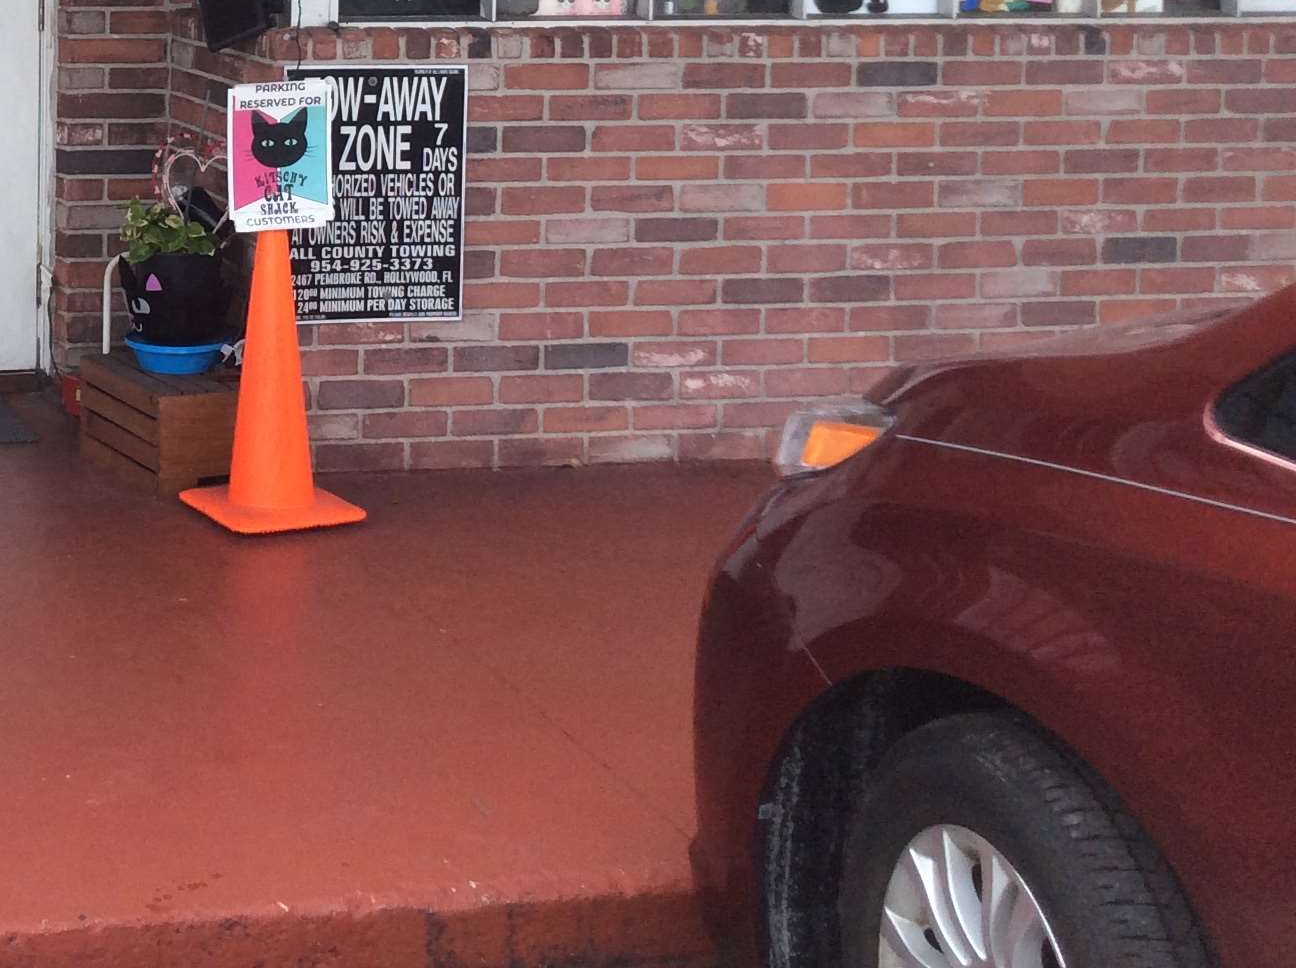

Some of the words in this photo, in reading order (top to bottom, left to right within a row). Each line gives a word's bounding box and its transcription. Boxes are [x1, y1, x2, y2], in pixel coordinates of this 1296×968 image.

[256, 82, 305, 93] PARKING
[240, 97, 296, 109] RESERVED
[298, 96, 321, 106] FOR
[434, 123, 448, 145] 7
[339, 124, 412, 171] ZONE
[423, 147, 458, 171] DAYS
[264, 184, 294, 201] CAT
[381, 173, 434, 196] VEHICLES
[438, 173, 455, 196] OR
[260, 201, 298, 215] SHACK
[340, 197, 366, 220] WILL
[369, 197, 384, 220] BE
[388, 197, 427, 220] TOWED
[431, 197, 460, 220] AWAY
[246, 214, 315, 226] CUSTOMERS
[308, 220, 356, 246] OWNERS
[360, 220, 387, 244] RISK
[390, 220, 399, 243] &
[403, 220, 454, 243] EXPENSE
[289, 247, 316, 260] ALL
[321, 245, 384, 259] COUNTY
[390, 244, 456, 258] TOWING
[310, 258, 433, 272] 954-925-3373
[314, 272, 362, 285] PEMBROKE
[442, 270, 453, 283] FL
[320, 286, 364, 300] MINIMUM
[407, 284, 446, 298] CHARGE
[320, 300, 364, 313] MINIMUM
[367, 299, 386, 312] PER
[387, 298, 407, 311] DAY
[409, 297, 455, 311] STORAGE
